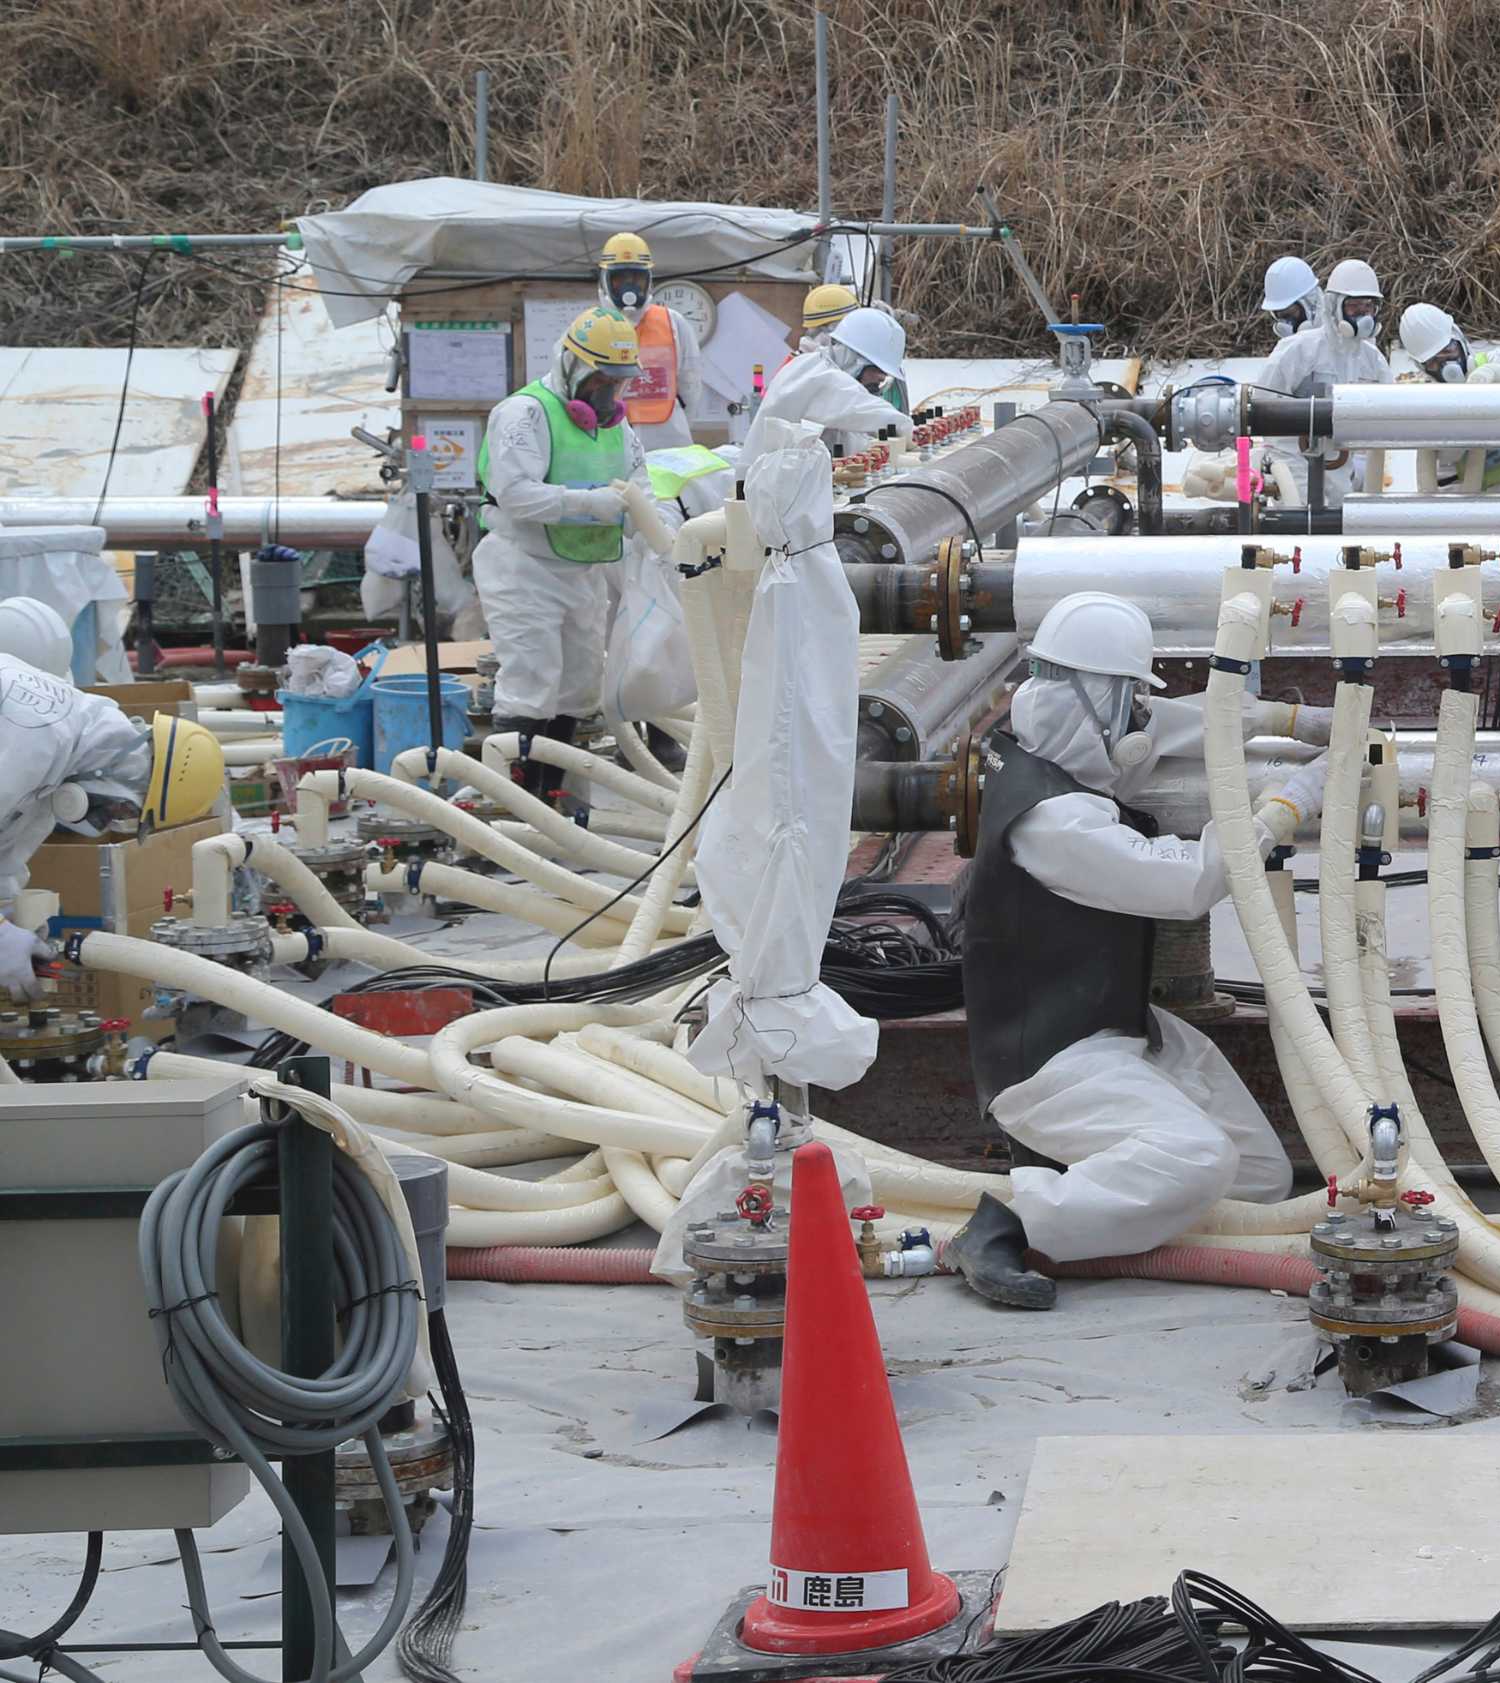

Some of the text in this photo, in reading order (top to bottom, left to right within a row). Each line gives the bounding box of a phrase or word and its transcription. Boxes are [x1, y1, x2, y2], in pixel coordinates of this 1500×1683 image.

[675, 289, 684, 299] 12
[1266, 756, 1282, 768] 16
[803, 1575, 864, 1608] 鹿島
